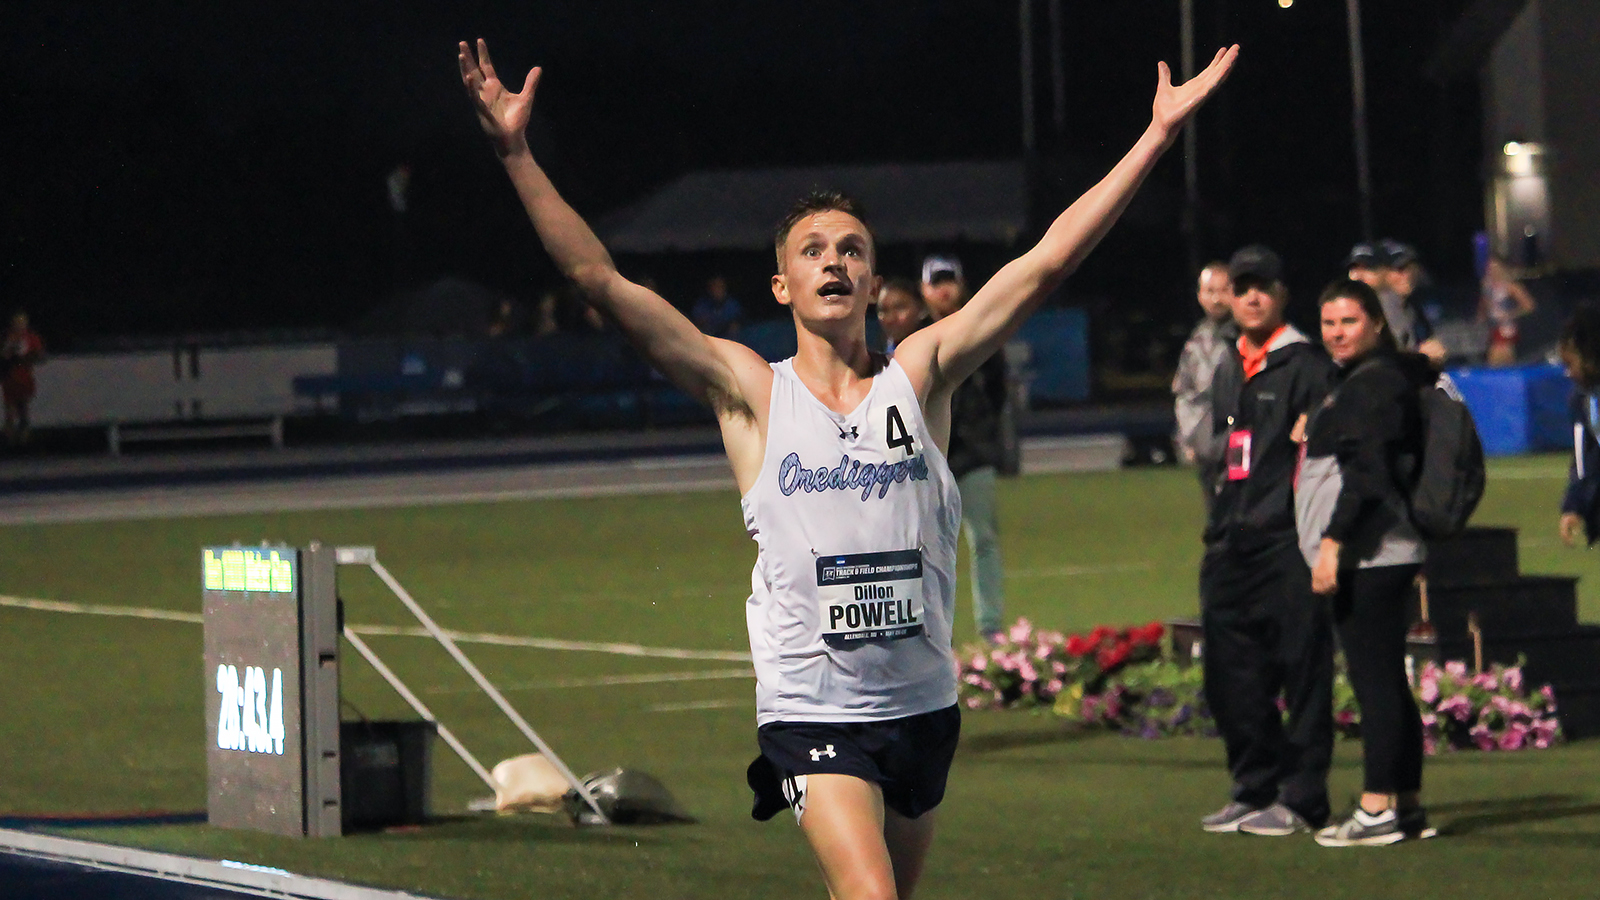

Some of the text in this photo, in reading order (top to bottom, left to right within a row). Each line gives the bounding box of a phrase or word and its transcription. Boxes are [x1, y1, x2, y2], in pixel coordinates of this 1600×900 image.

[886, 405, 914, 455] 4
[836, 567, 854, 577] TRACK
[860, 566, 875, 575] FIELD
[875, 563, 918, 574] CHAMPIONSHIPS
[854, 585, 894, 600] Dillon
[829, 599, 917, 630] POWELL
